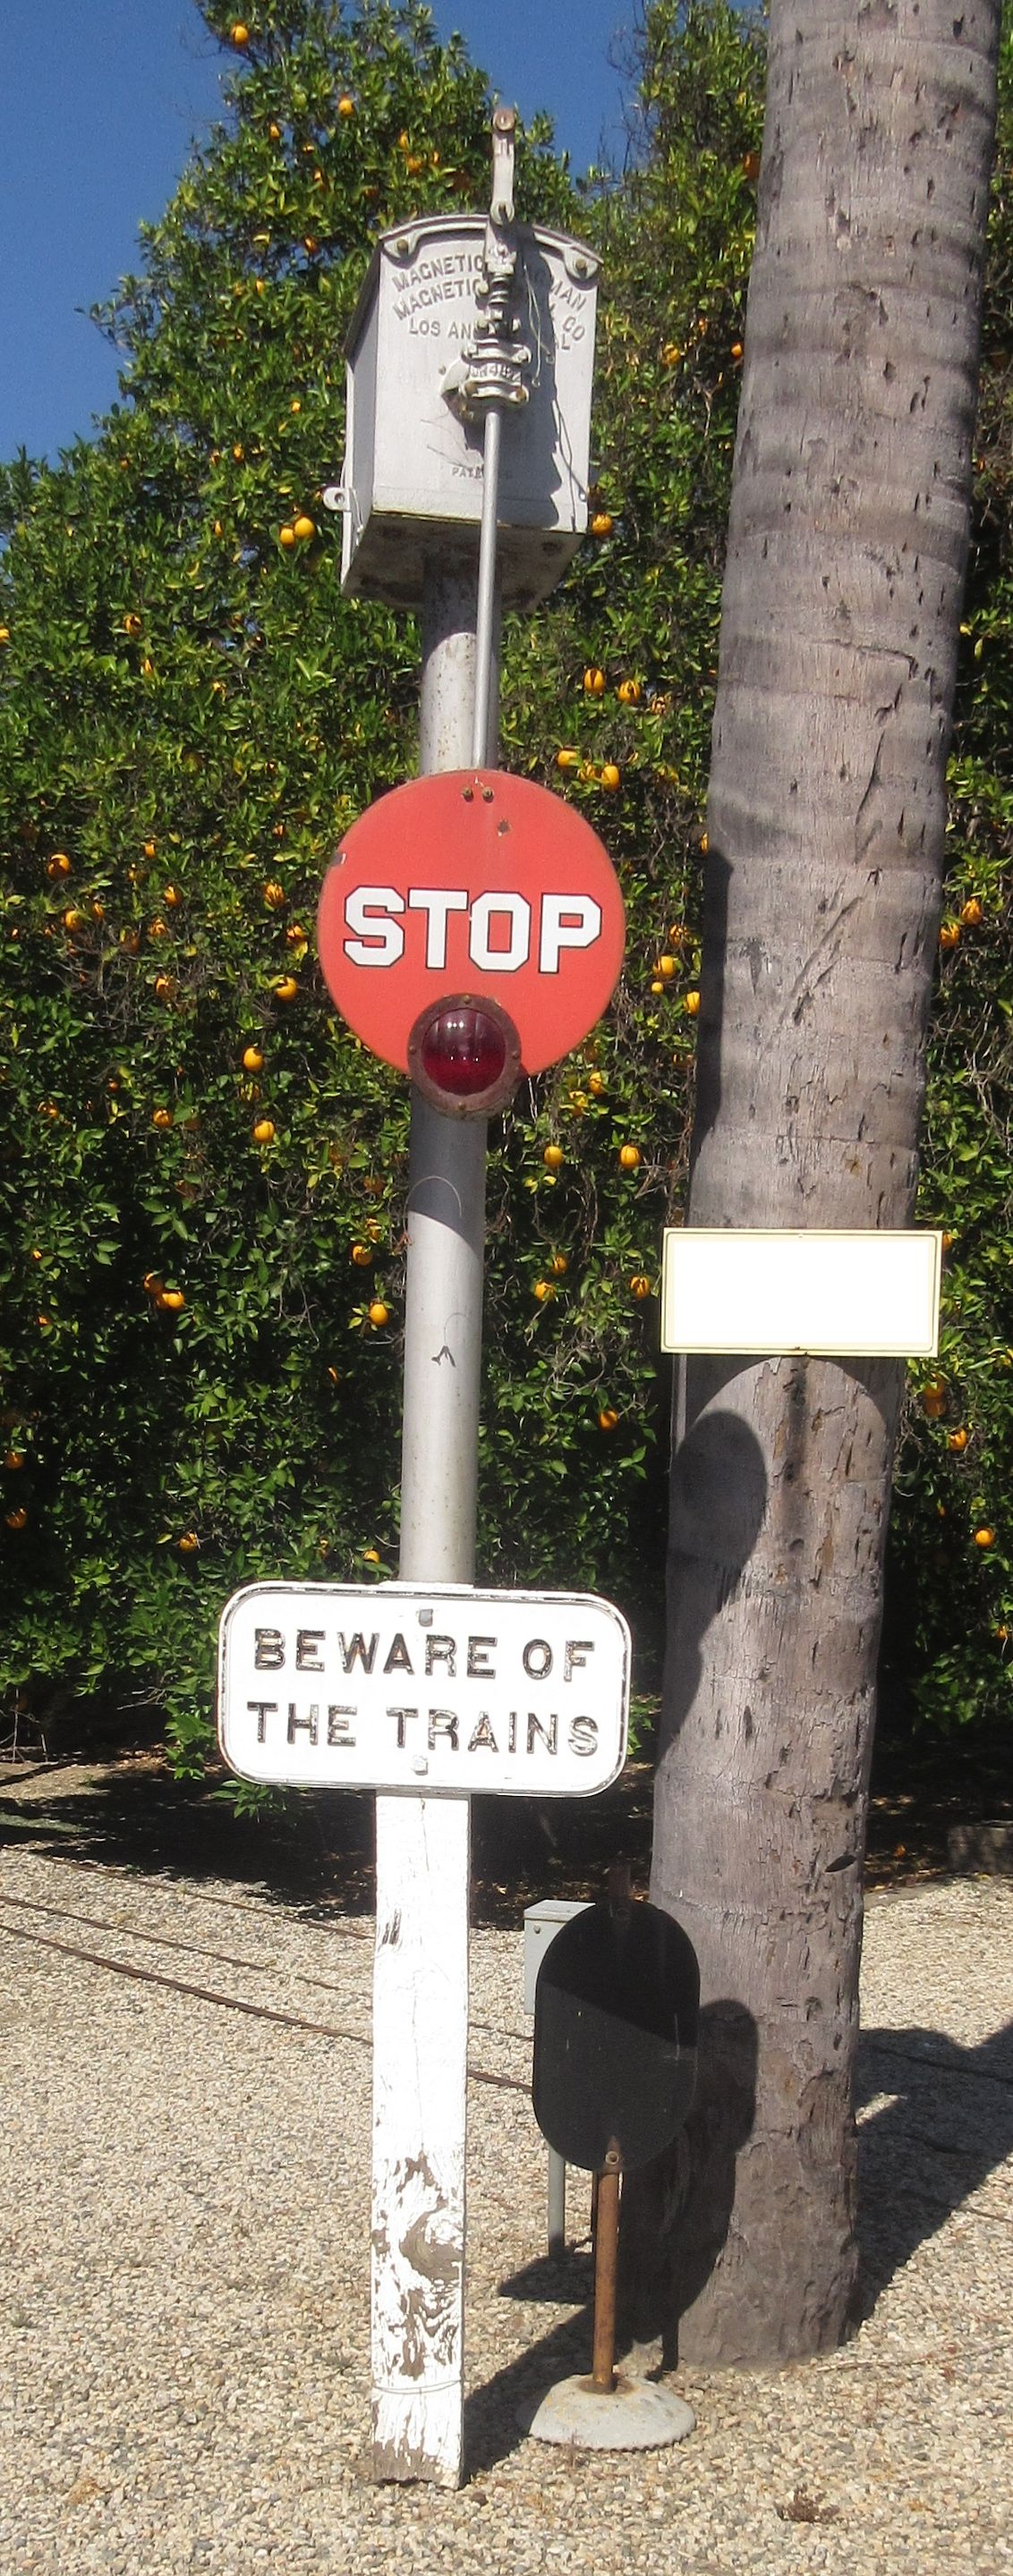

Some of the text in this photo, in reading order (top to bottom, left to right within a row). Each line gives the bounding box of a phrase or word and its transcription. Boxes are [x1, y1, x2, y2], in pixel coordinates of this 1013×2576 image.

[391, 253, 485, 293] MAGNETIC
[409, 317, 441, 338] LOS
[344, 885, 602, 974] STOP
[253, 1627, 596, 1683] BEWARE OF
[246, 1700, 600, 1757] THE TRAINS
